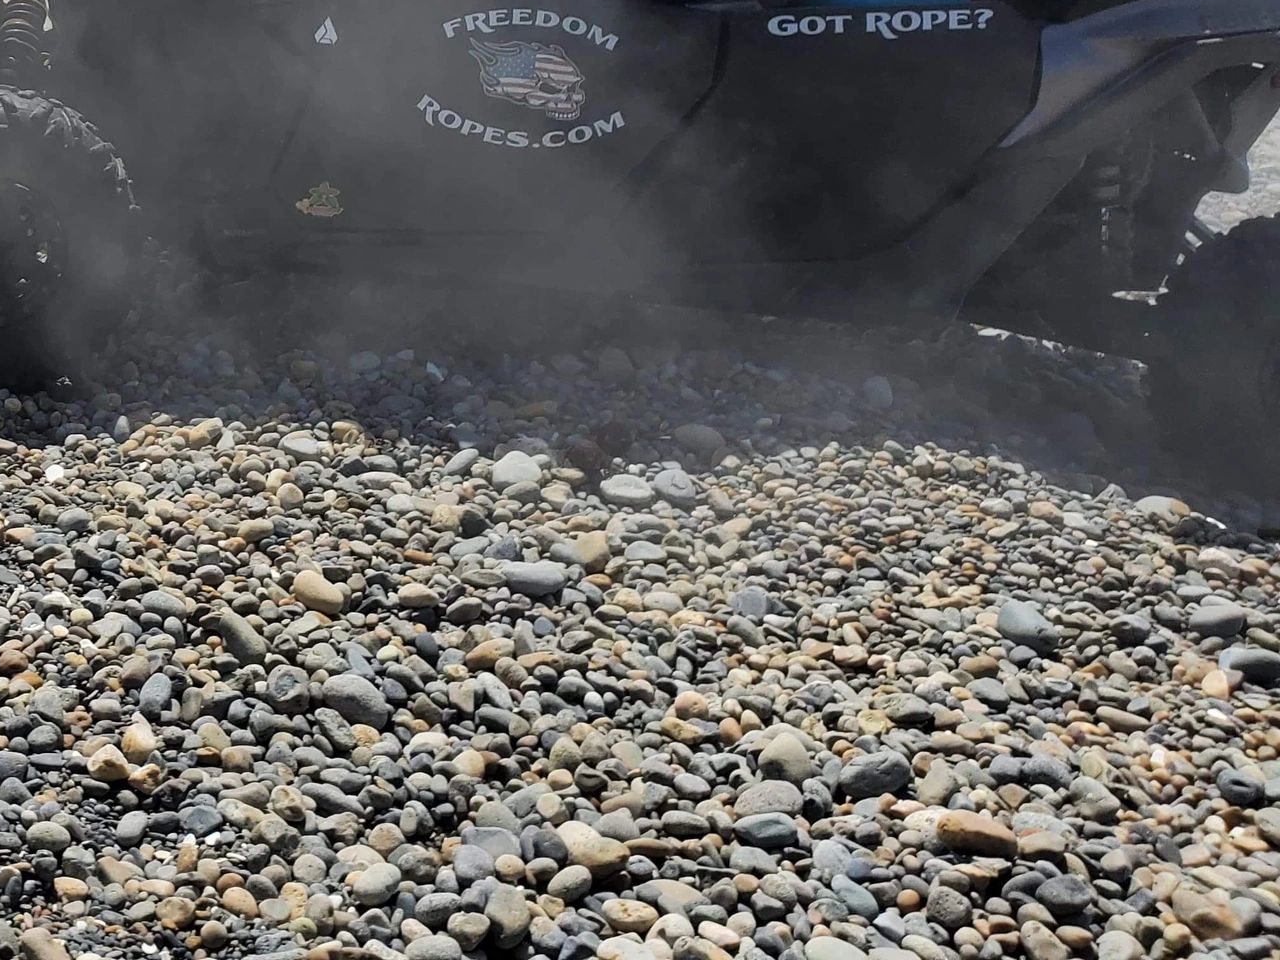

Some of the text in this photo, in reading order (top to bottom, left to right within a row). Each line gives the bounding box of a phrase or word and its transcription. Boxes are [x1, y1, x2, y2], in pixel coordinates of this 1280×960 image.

[442, 8, 620, 52] FREEDOM
[767, 8, 994, 40] GOT ROPE?
[416, 93, 626, 148] ROPES.COM
